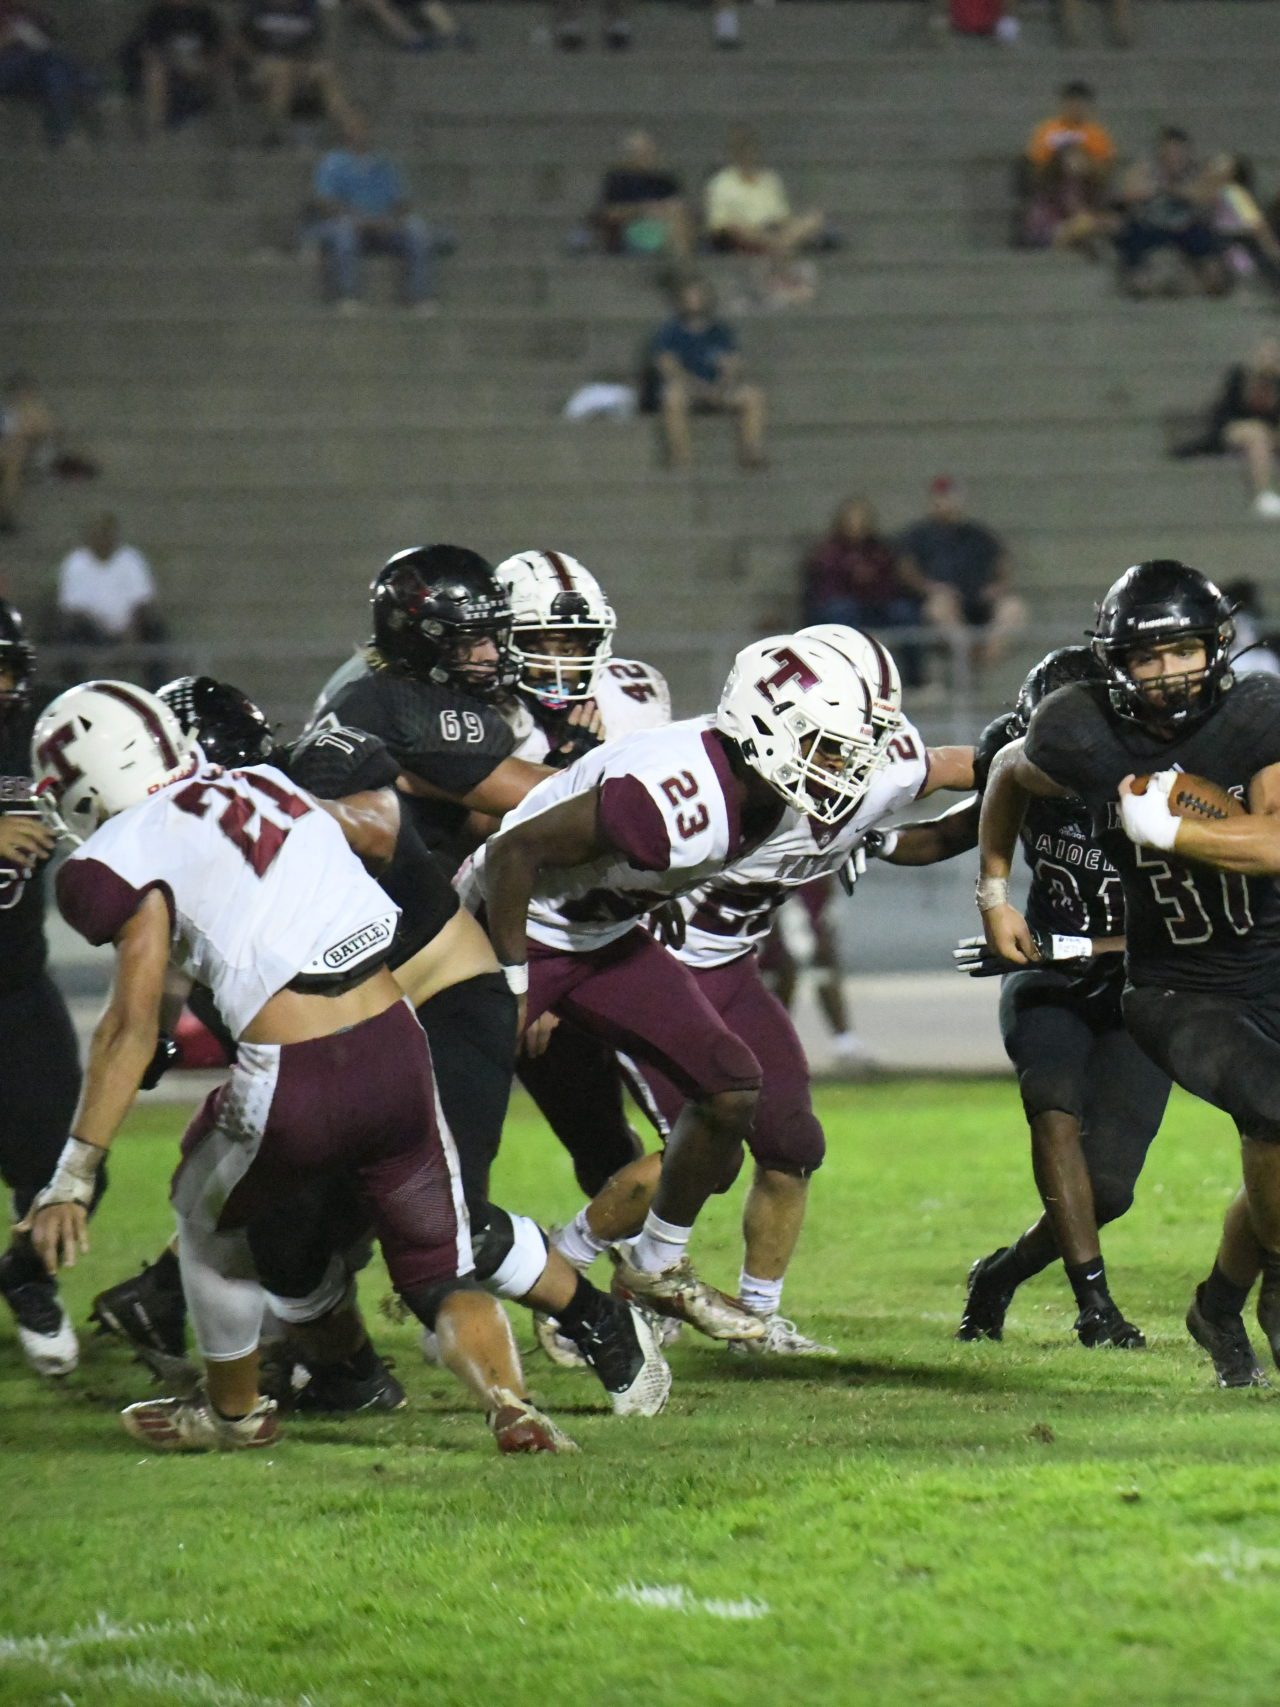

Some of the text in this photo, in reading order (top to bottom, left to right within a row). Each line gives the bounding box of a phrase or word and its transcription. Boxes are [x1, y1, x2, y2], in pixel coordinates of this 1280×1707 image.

[754, 646, 822, 705] T
[37, 720, 84, 795] T
[439, 709, 485, 743] 69
[172, 770, 312, 879] 21
[658, 768, 709, 841] 23
[329, 926, 384, 963] BATTLE
